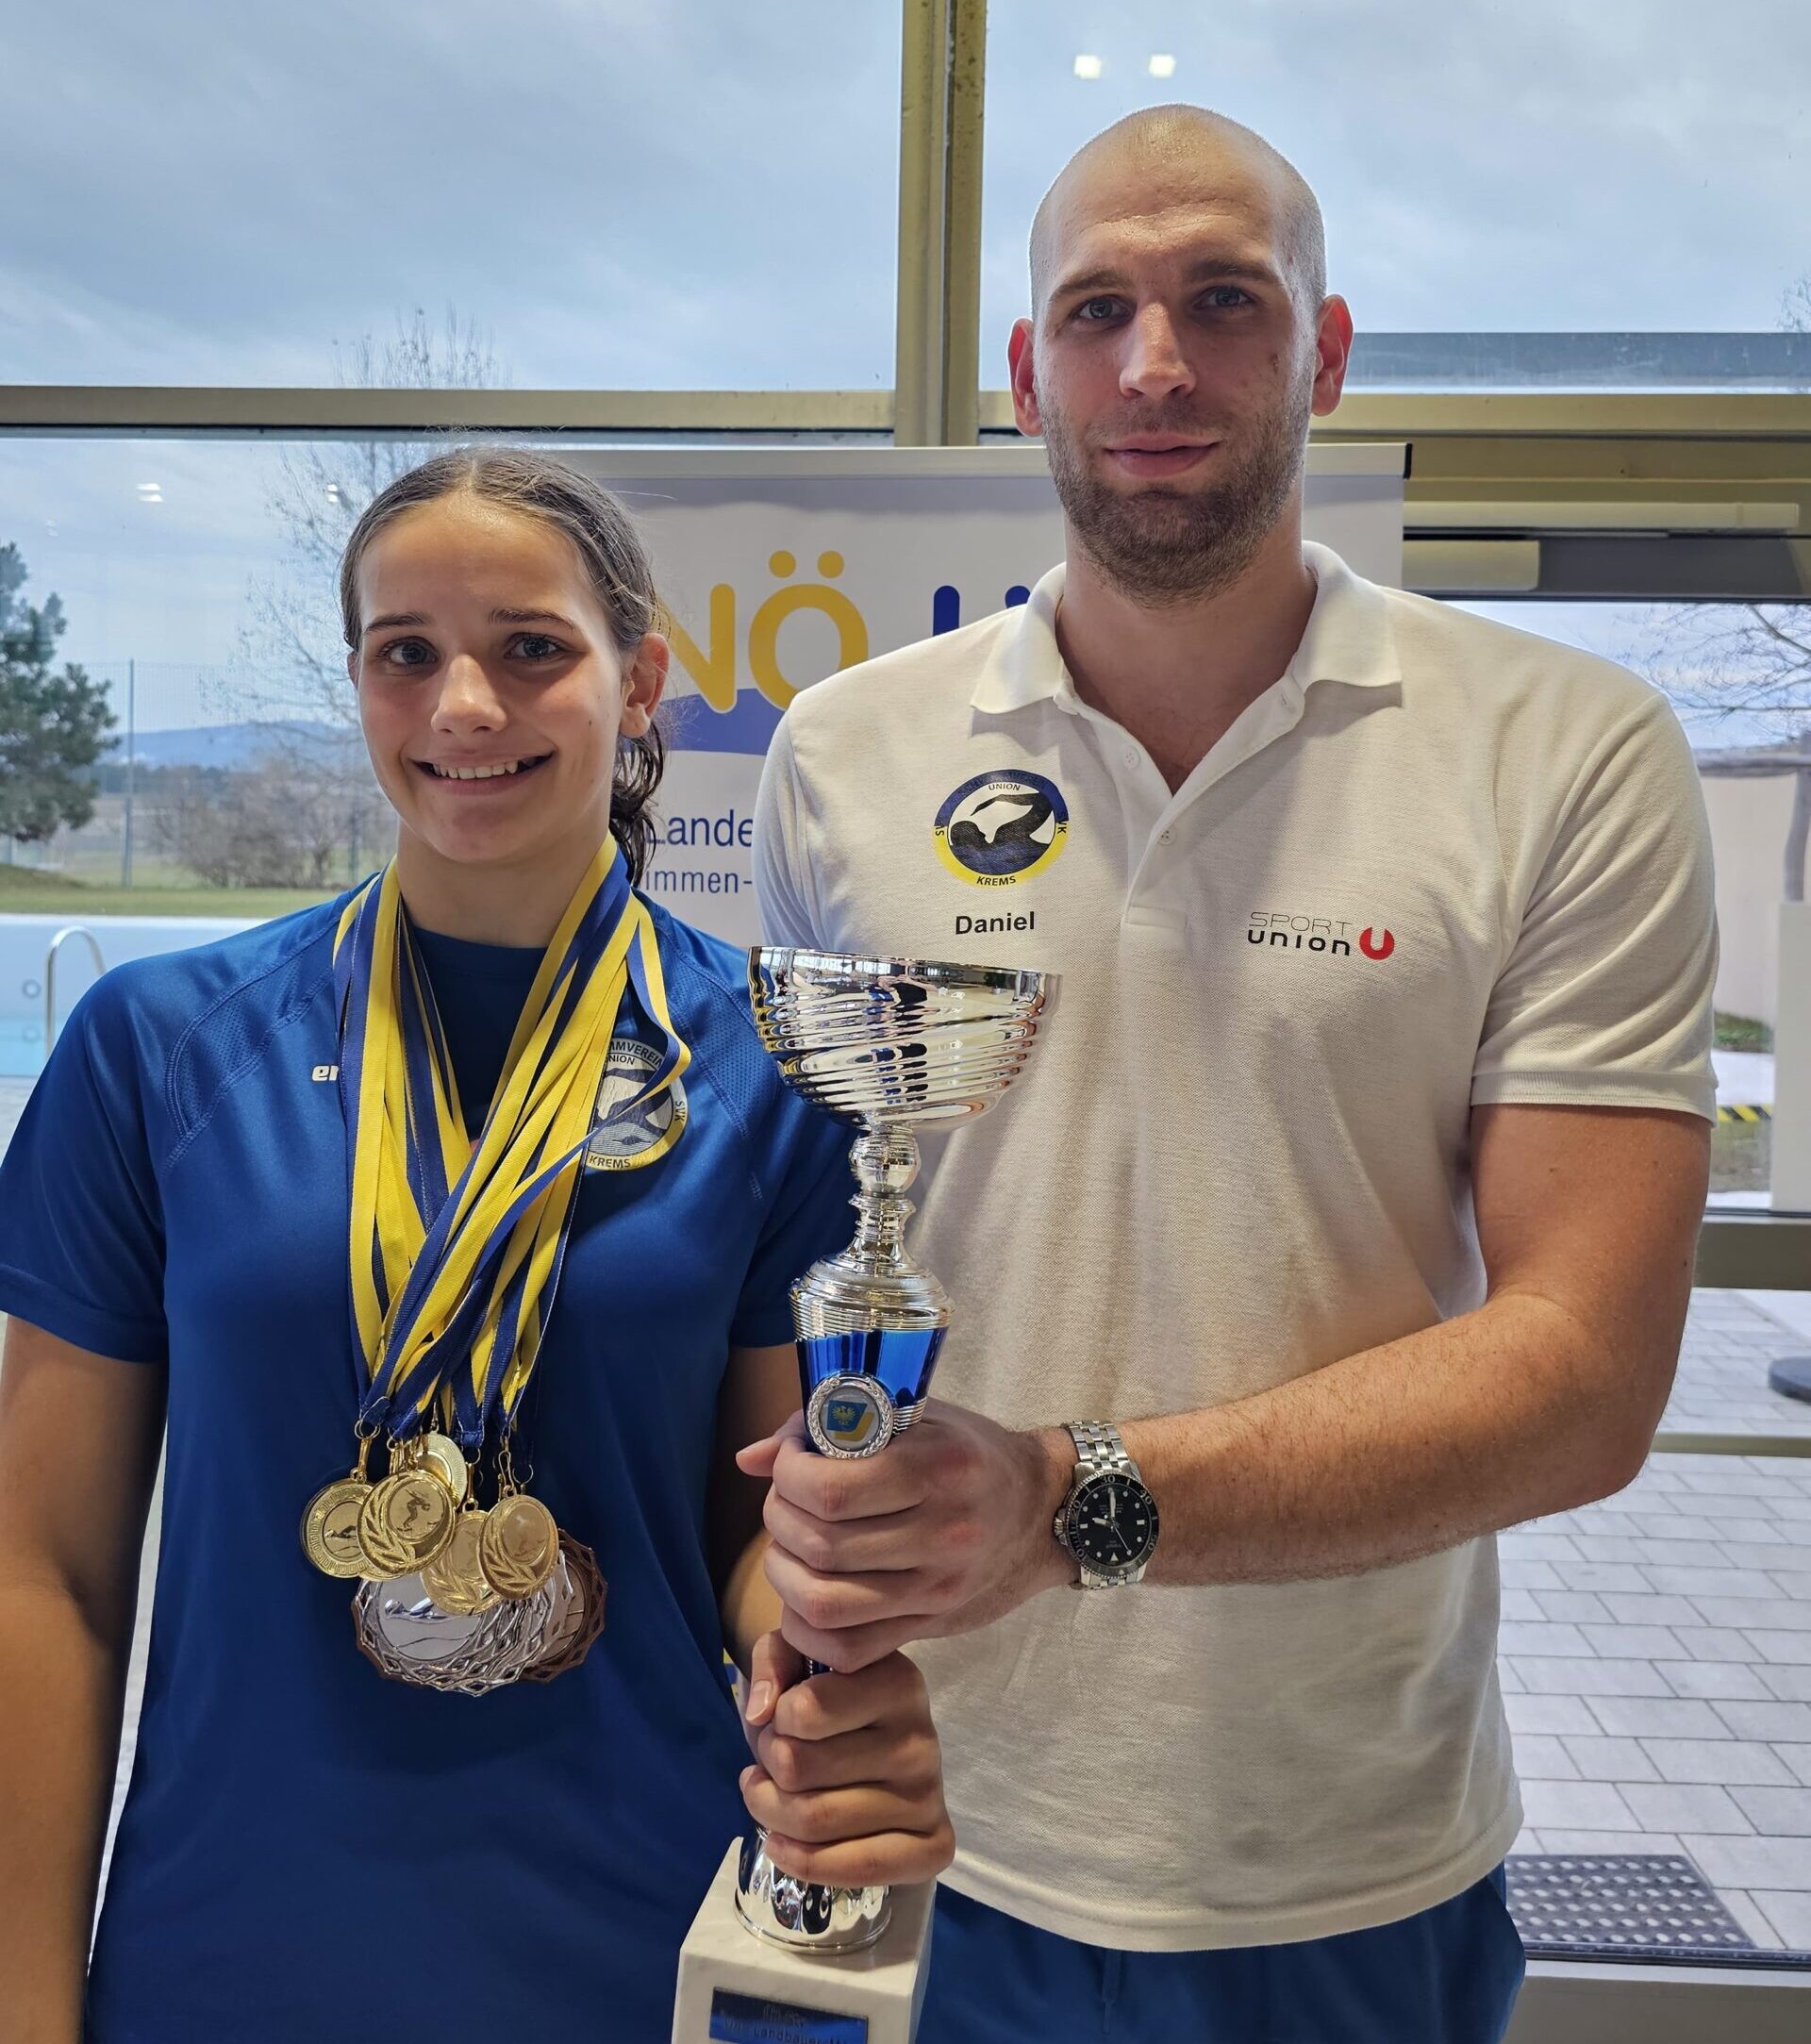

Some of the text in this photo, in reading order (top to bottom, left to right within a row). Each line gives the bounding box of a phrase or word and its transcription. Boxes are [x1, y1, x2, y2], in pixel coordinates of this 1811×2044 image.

[988, 783, 1021, 791] UNION
[976, 875, 1017, 887] KREMS
[955, 911, 1035, 935] Daniel
[1249, 911, 1353, 937] SPORT
[674, 1100, 687, 1122] SVK
[589, 1155, 631, 1169] KREMS
